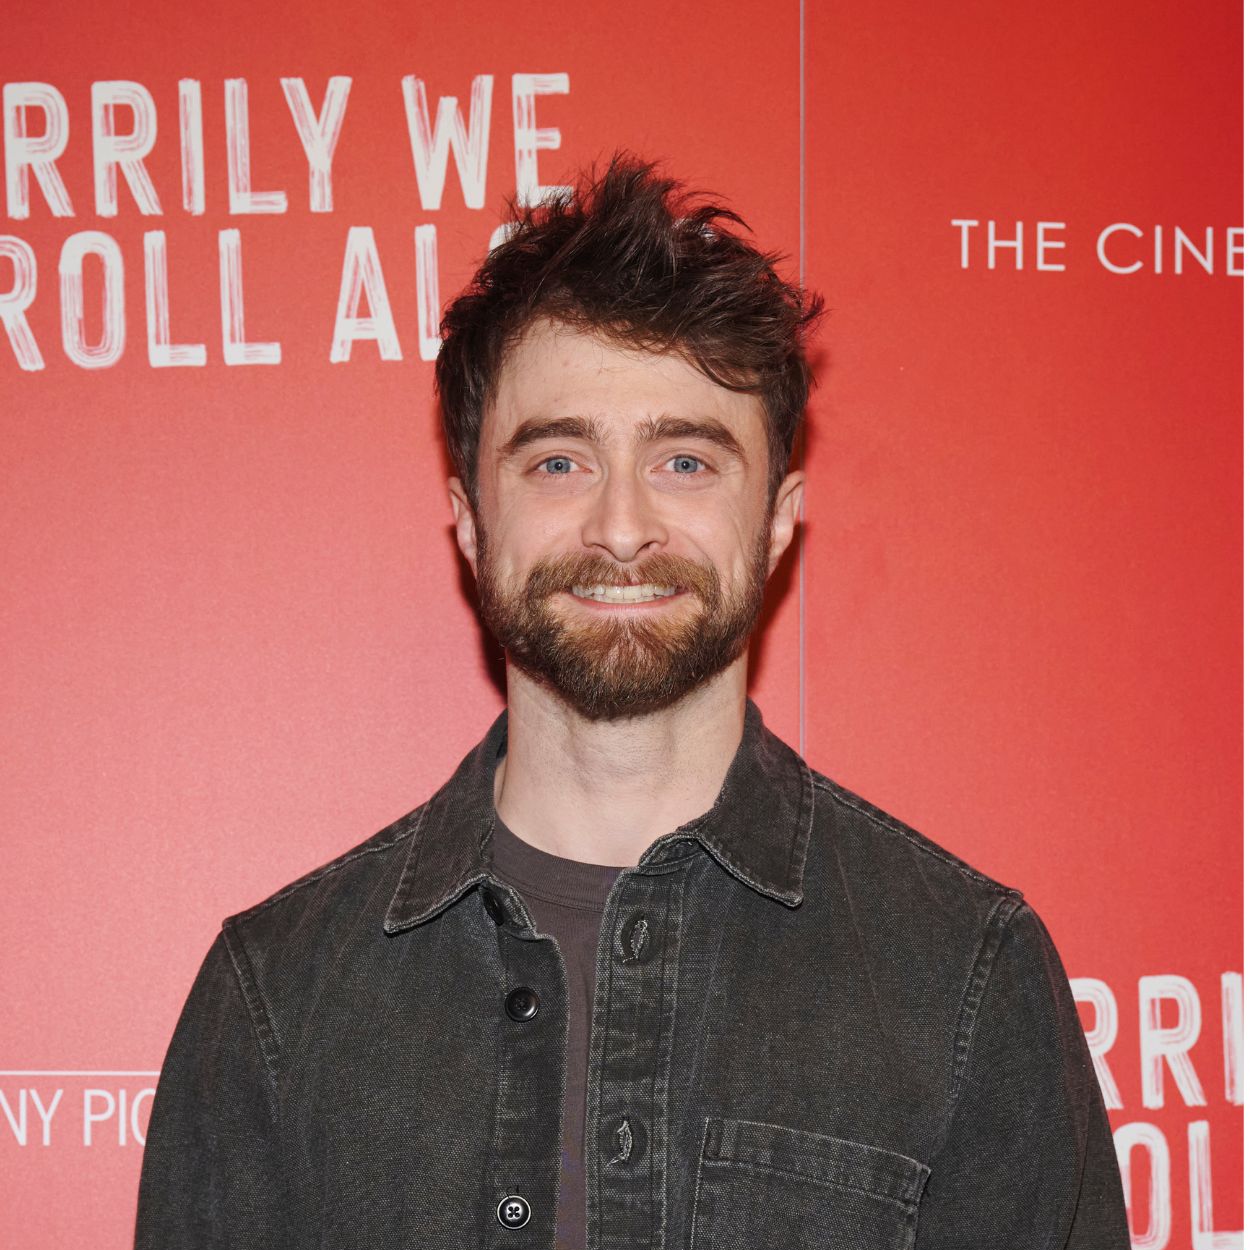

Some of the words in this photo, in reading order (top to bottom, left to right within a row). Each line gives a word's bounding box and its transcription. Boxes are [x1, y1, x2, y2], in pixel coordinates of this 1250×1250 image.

[402, 73, 574, 211] WE
[951, 219, 1066, 271] THE
[1096, 222, 1244, 277] CINE
